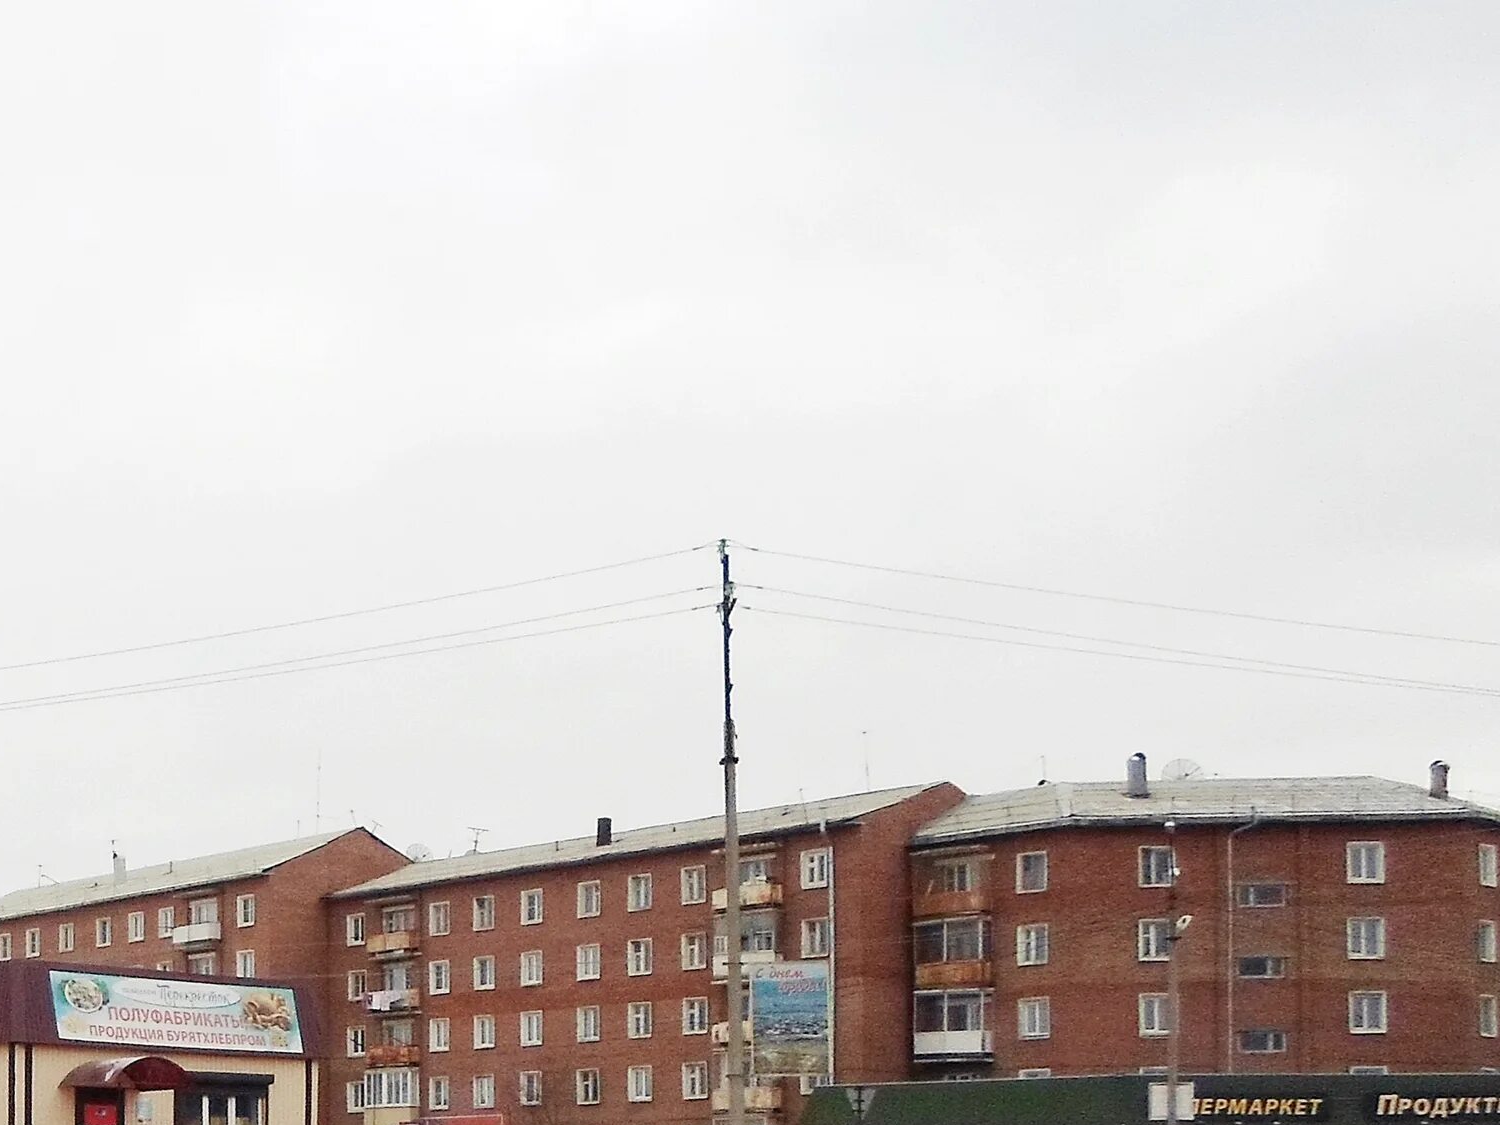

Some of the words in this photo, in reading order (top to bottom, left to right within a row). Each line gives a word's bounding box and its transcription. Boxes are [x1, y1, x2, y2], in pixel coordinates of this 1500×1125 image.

[107, 1005, 248, 1030] ПОЛУФАБРИКАТЫ
[89, 1024, 164, 1042] ПРОДУКЦИЯ
[166, 1030, 266, 1047] БУРЯТХЛЕБПРОМ
[1376, 1094, 1500, 1118] ПРОДУКТ
